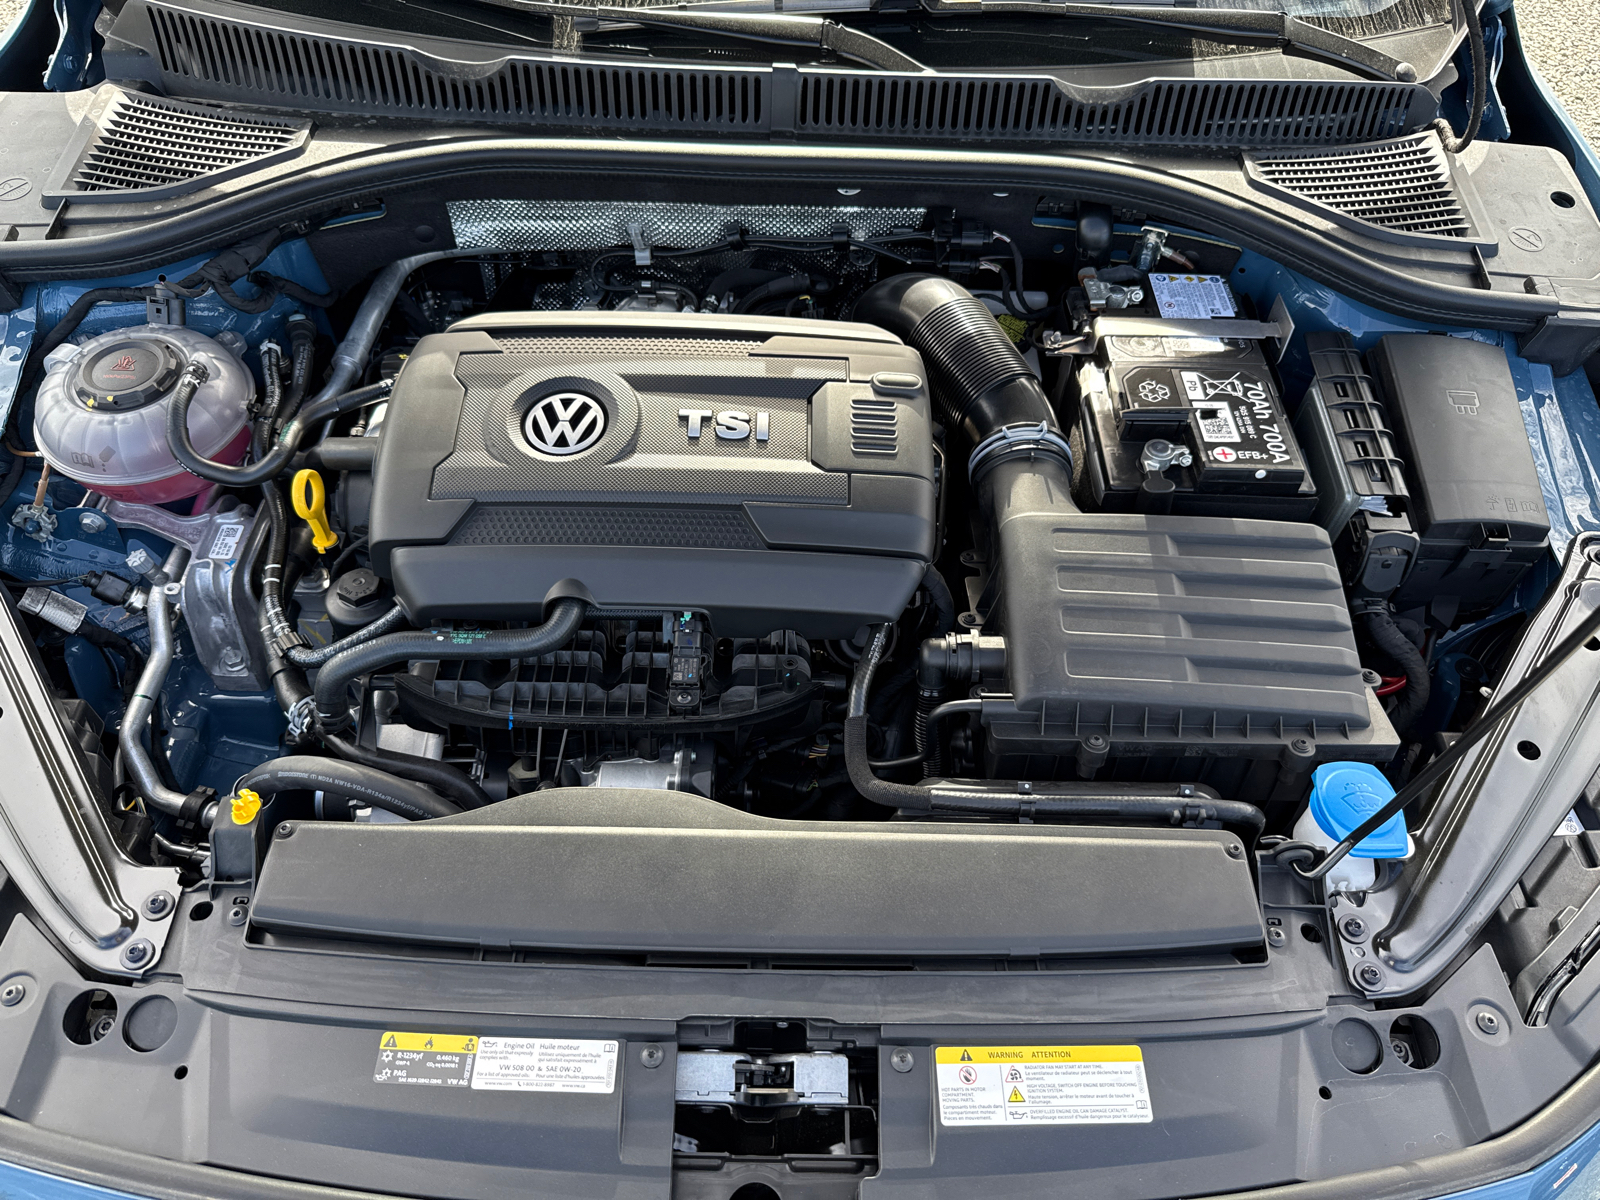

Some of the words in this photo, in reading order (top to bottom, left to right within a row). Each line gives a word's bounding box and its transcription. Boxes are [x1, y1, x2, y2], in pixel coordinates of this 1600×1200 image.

[1186, 380, 1198, 391] Pb
[525, 392, 606, 455] VW
[678, 407, 770, 442] TSI
[1244, 382, 1272, 418] 70Ah
[1259, 424, 1290, 463] 700A
[1237, 450, 1268, 459] EFB+
[397, 1052, 424, 1061] R-1234yf
